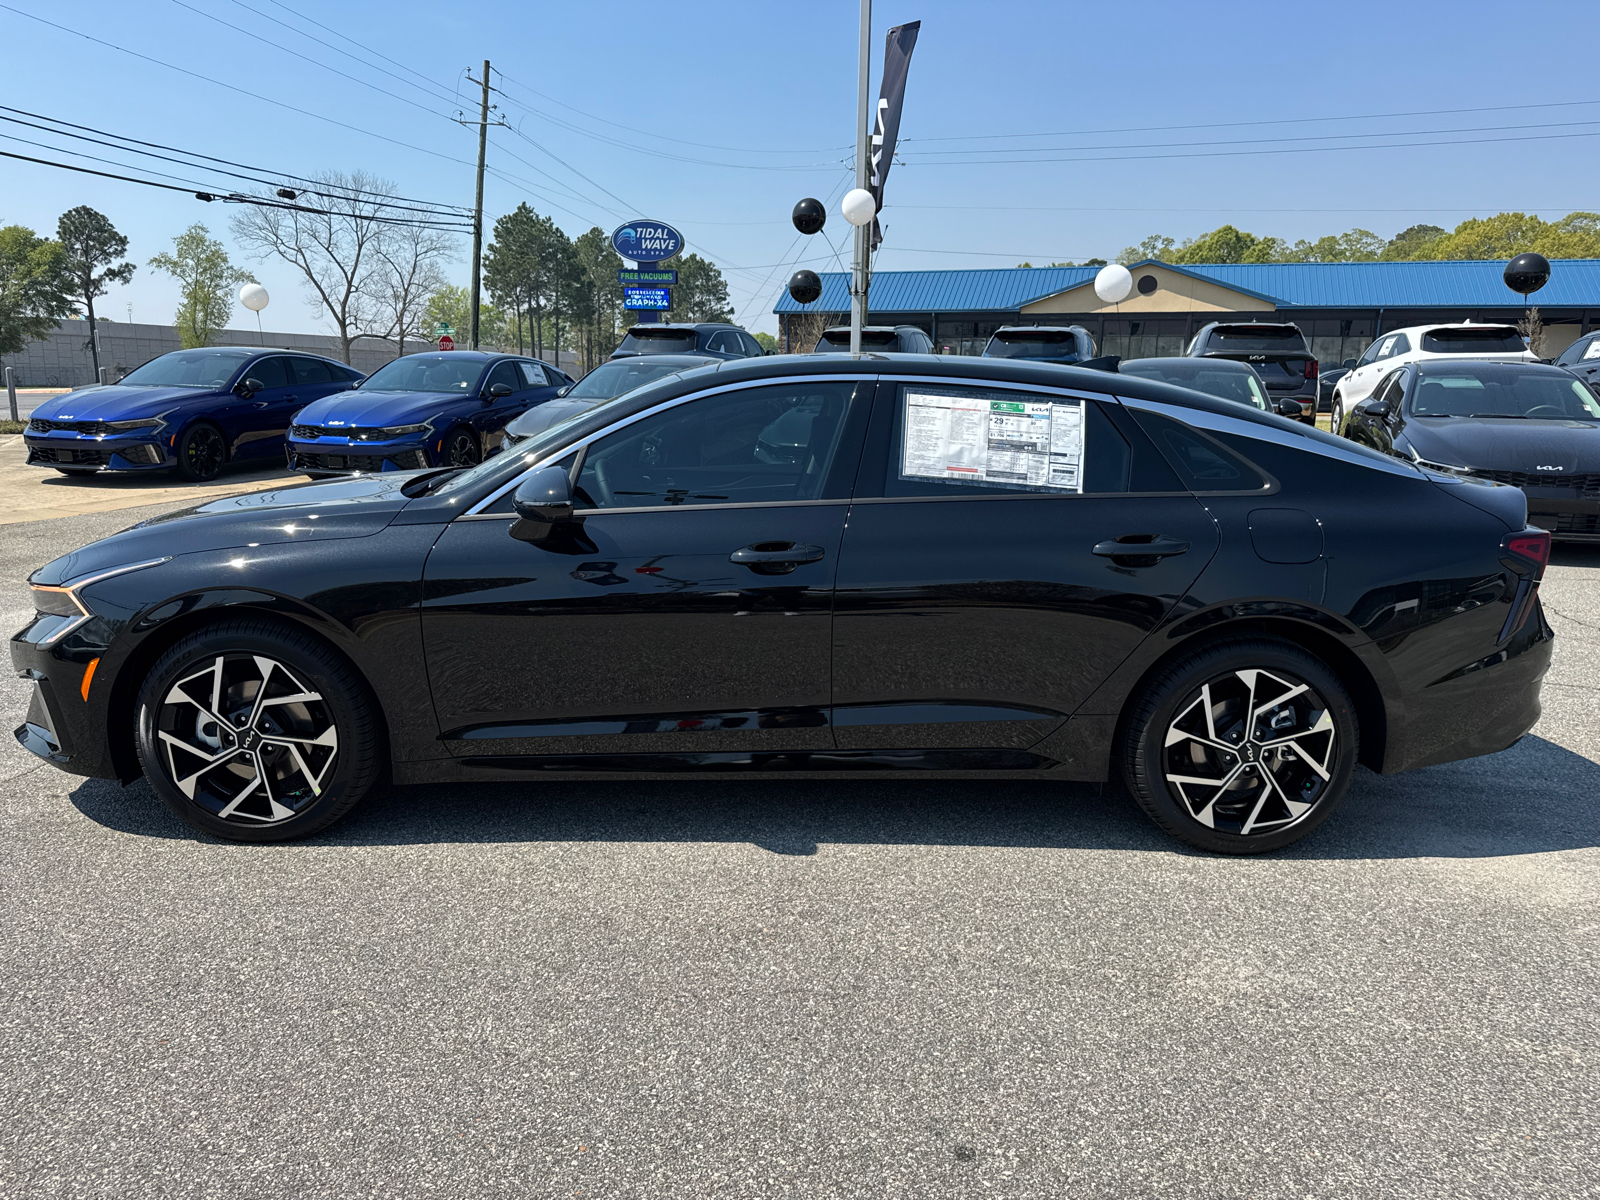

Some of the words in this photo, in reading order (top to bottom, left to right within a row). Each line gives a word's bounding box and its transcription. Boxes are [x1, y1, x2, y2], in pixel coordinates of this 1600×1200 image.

[636, 228, 668, 238] TIDAL
[642, 239, 676, 250] WAVE
[439, 341, 454, 350] STOP
